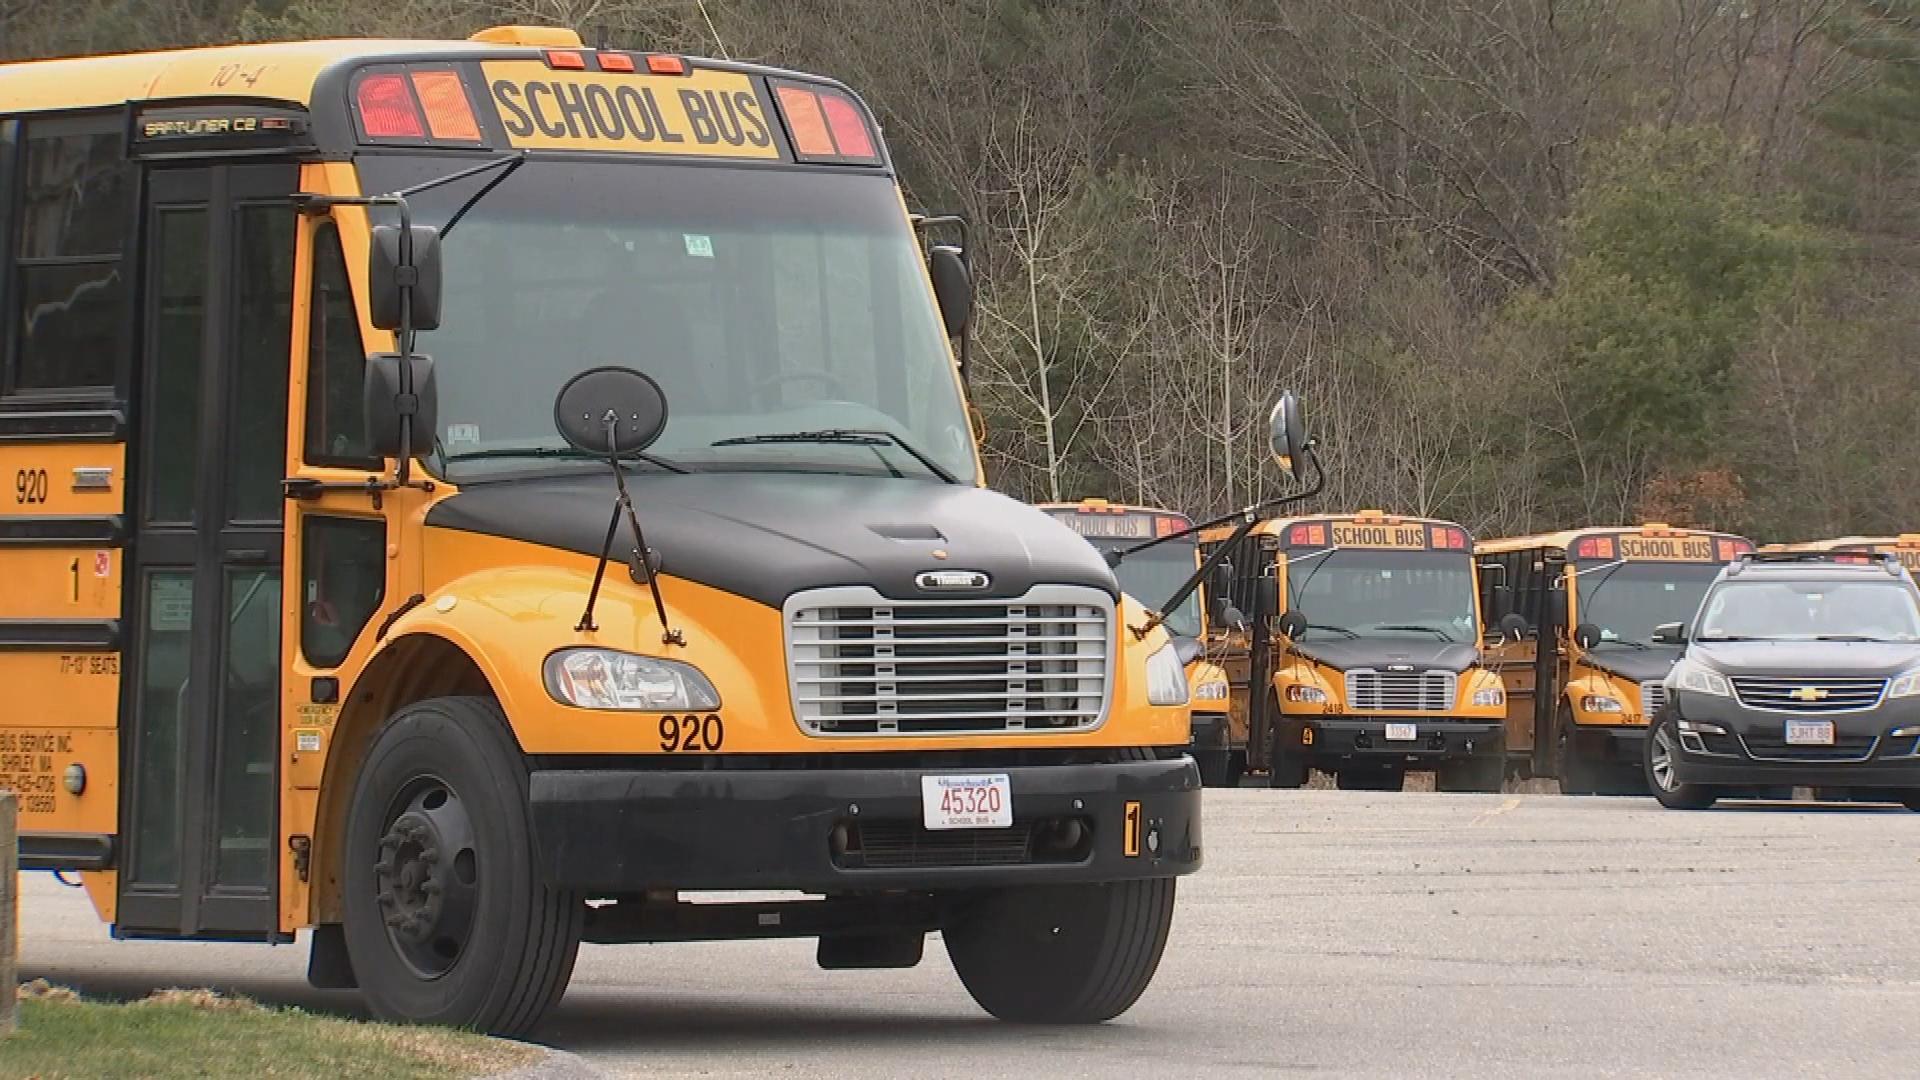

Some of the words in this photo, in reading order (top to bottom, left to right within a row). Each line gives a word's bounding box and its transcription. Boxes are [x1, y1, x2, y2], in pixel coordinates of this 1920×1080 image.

[233, 117, 256, 131] C2
[492, 79, 685, 143] SCHOOL
[677, 88, 770, 147] BUS
[16, 468, 48, 504] 920
[1065, 514, 1110, 536] SCHOOL
[1114, 515, 1138, 536] BUS
[1333, 527, 1391, 545] SCHOOL
[1395, 529, 1424, 546] BUS
[1621, 540, 1679, 557] SCHOOL
[1683, 541, 1712, 559] BUS
[71, 557, 80, 602] 1
[20, 734, 54, 752] SERVICE
[659, 713, 724, 752] 920
[1304, 729, 1312, 744] 4
[941, 786, 1000, 814] 45320
[1127, 805, 1138, 852] 1
